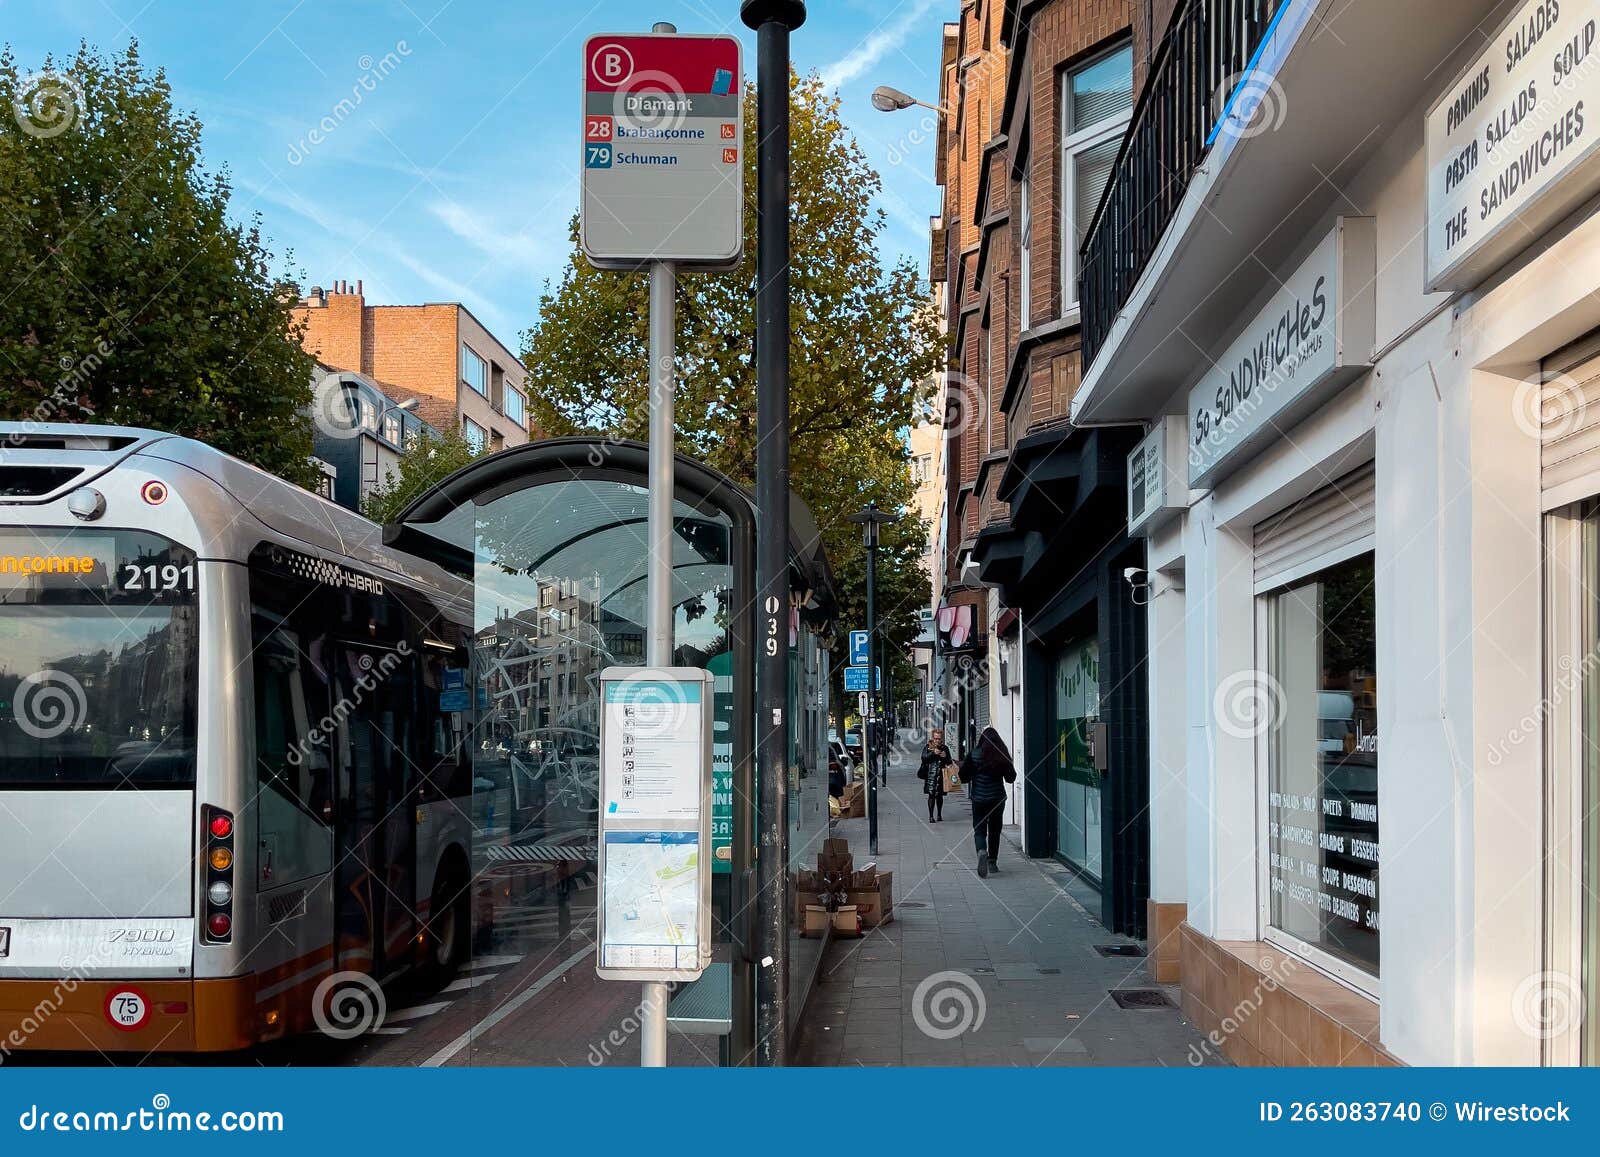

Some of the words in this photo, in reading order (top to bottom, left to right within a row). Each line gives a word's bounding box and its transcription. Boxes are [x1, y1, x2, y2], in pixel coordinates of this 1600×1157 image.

[605, 54, 622, 76] B
[1447, 65, 1490, 136] PANINIS
[1506, 0, 1559, 73] SALADES
[626, 96, 693, 111] Diamant
[1446, 139, 1478, 194] PASTA
[1485, 79, 1536, 153] SALADS
[1553, 19, 1595, 86] SOUP
[587, 121, 611, 137] 28
[617, 126, 705, 141] Brabançonne
[587, 147, 610, 164] 79
[617, 152, 678, 165] Schuman
[1445, 206, 1467, 250] THE
[1480, 100, 1584, 221] SANDWICHES
[0, 556, 95, 576] nçonne
[124, 565, 194, 590] 2191
[339, 569, 384, 595] HYBRID
[855, 634, 868, 651] P
[1322, 798, 1342, 816] SWEETS
[1350, 801, 1377, 822] DRANKEN
[1319, 832, 1344, 853] SALADES
[1322, 866, 1340, 887] SOUPE
[1342, 872, 1376, 898] DESSERTEN
[107, 928, 176, 942] 7900
[116, 998, 139, 1014] 75
[121, 1014, 135, 1023] km
